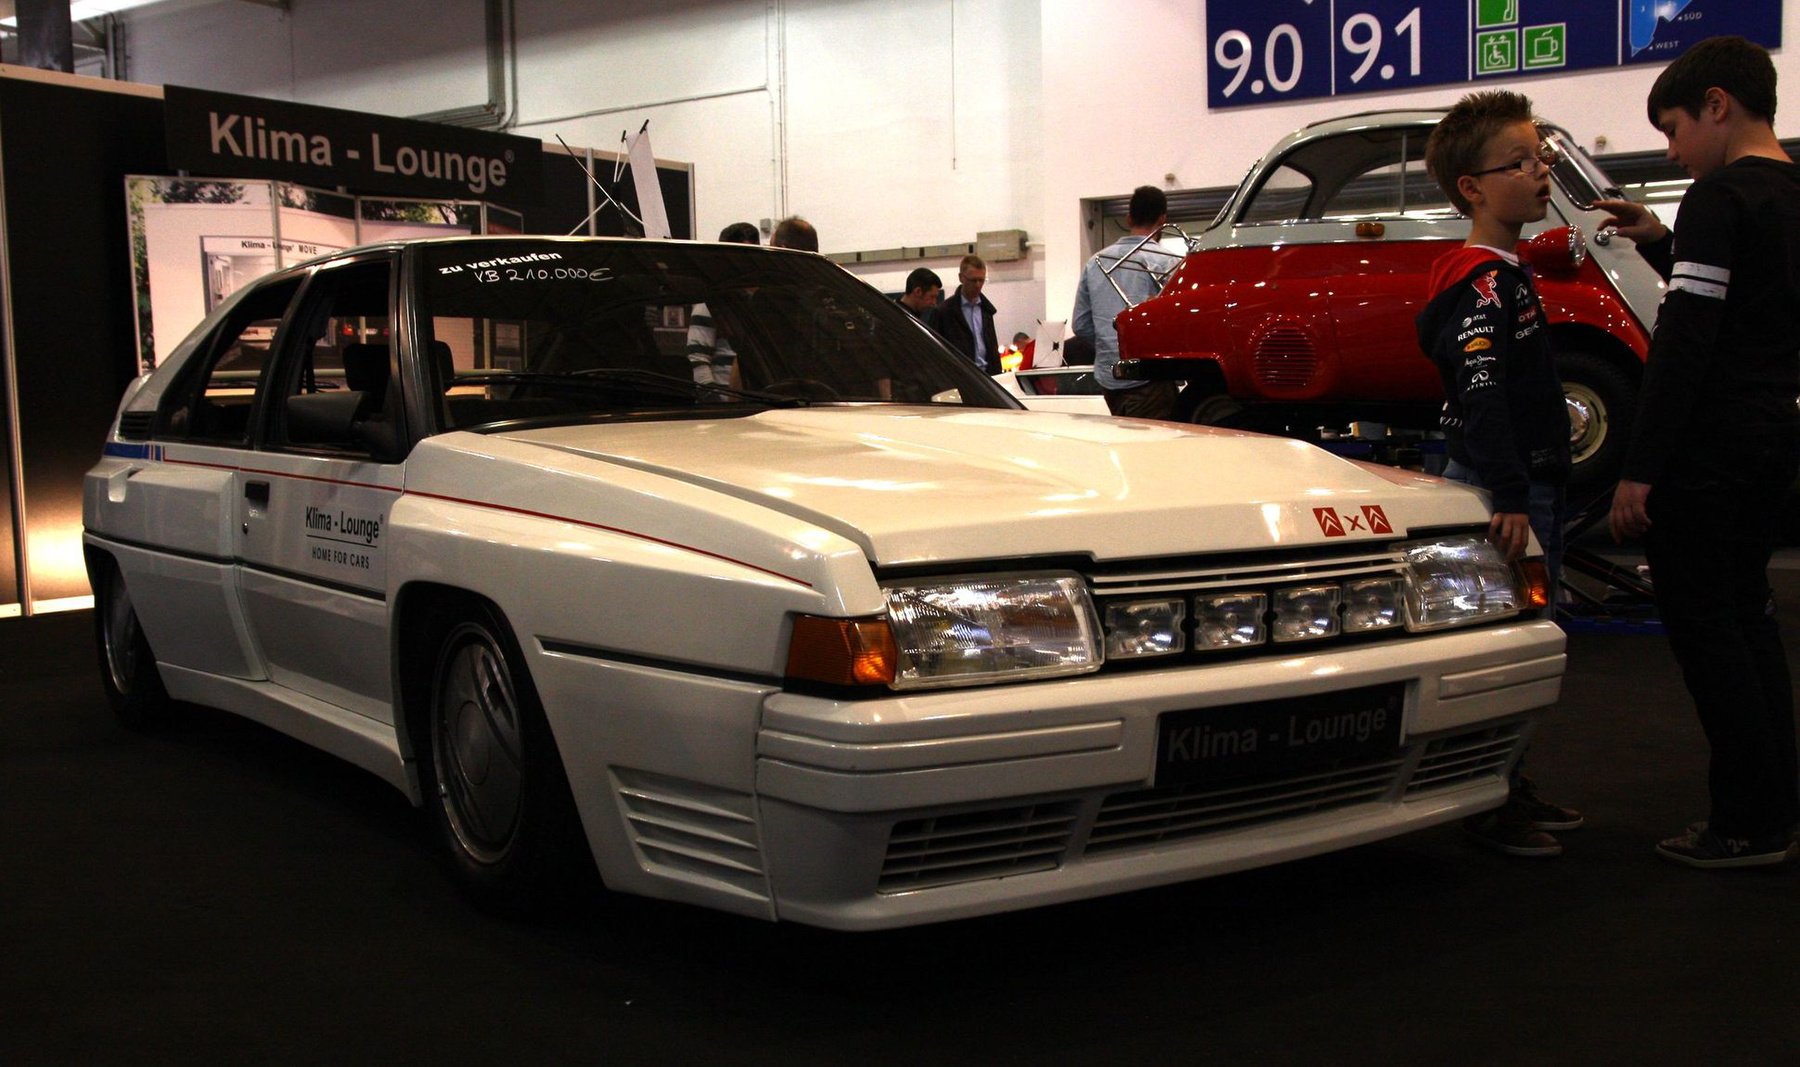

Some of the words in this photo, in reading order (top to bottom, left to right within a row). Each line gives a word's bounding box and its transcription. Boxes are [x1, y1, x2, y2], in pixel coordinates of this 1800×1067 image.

[1342, 7, 1421, 84] 9.1
[1655, 40, 1680, 50] WEST
[1214, 23, 1303, 98] 9.0
[209, 111, 332, 167] Klima
[241, 240, 265, 249] Klima
[299, 244, 317, 255] MOVE
[438, 265, 463, 275] zu
[466, 252, 563, 269] verkaufen
[1457, 325, 1495, 341] RENAULT
[306, 506, 331, 531] Klima
[312, 547, 331, 562] HOME
[333, 551, 347, 565] FOR
[350, 554, 369, 569] CARS
[1167, 723, 1258, 762] Klima
